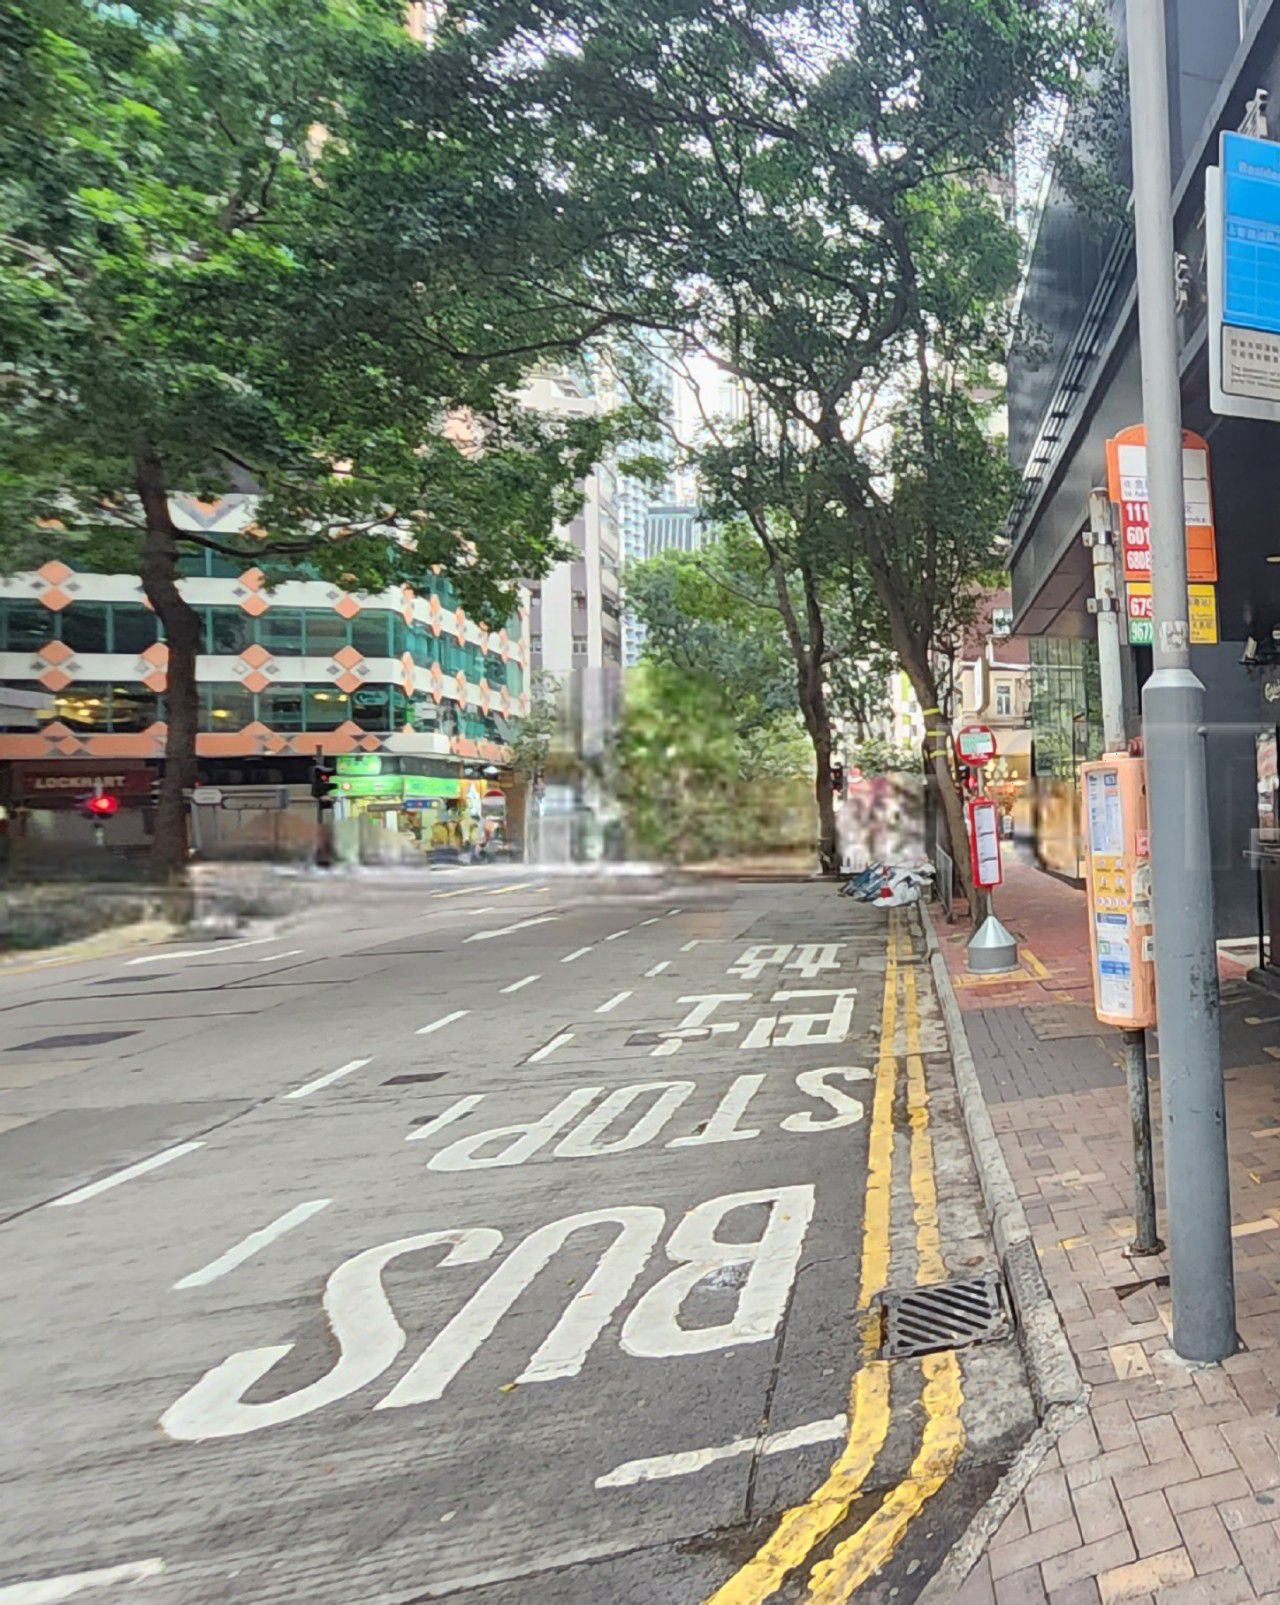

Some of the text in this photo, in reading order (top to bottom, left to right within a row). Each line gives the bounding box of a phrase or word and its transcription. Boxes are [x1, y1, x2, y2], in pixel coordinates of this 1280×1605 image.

[34, 775, 126, 789] LOCKHART
[427, 1067, 873, 1172] STOP
[158, 1184, 816, 1442] BUS
